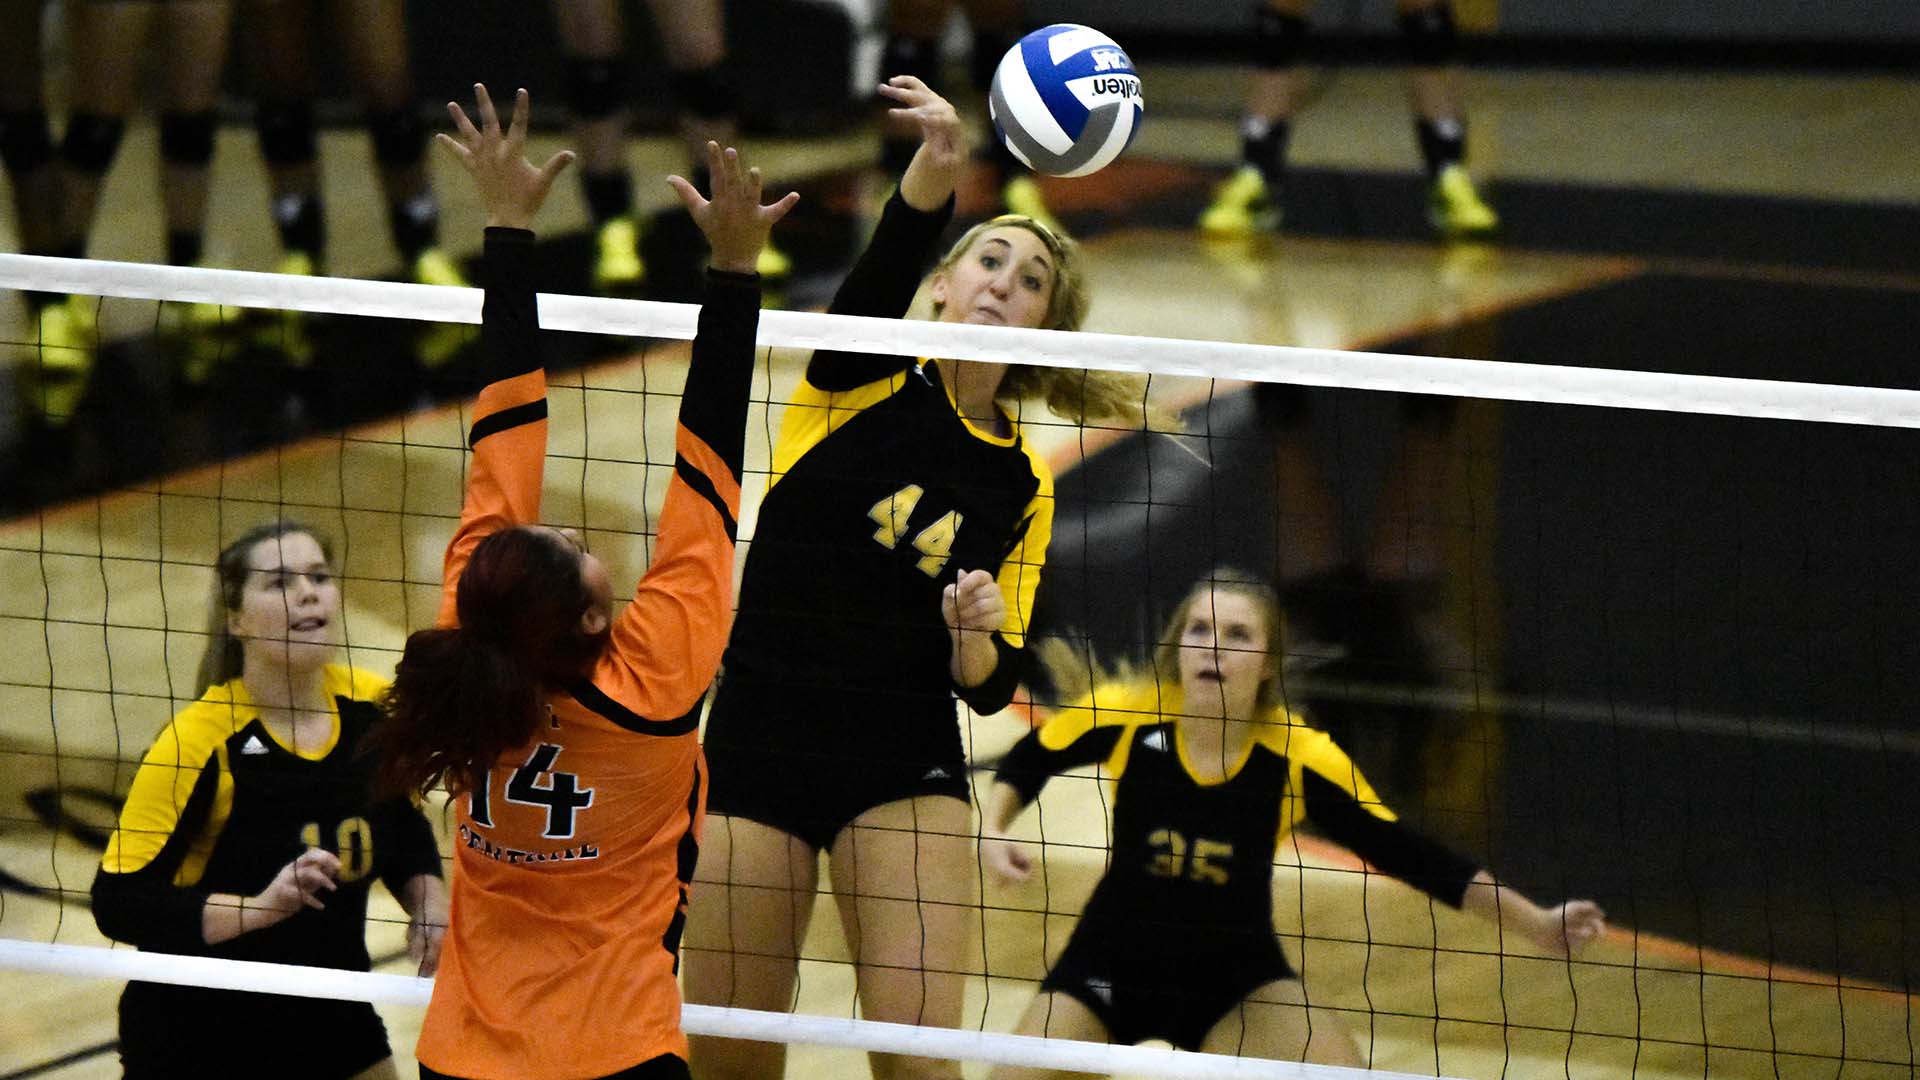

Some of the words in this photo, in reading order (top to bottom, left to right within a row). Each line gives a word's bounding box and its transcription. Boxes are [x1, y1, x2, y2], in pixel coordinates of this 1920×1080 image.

[1092, 77, 1143, 99] olten
[867, 483, 964, 579] 44
[468, 742, 596, 839] 14
